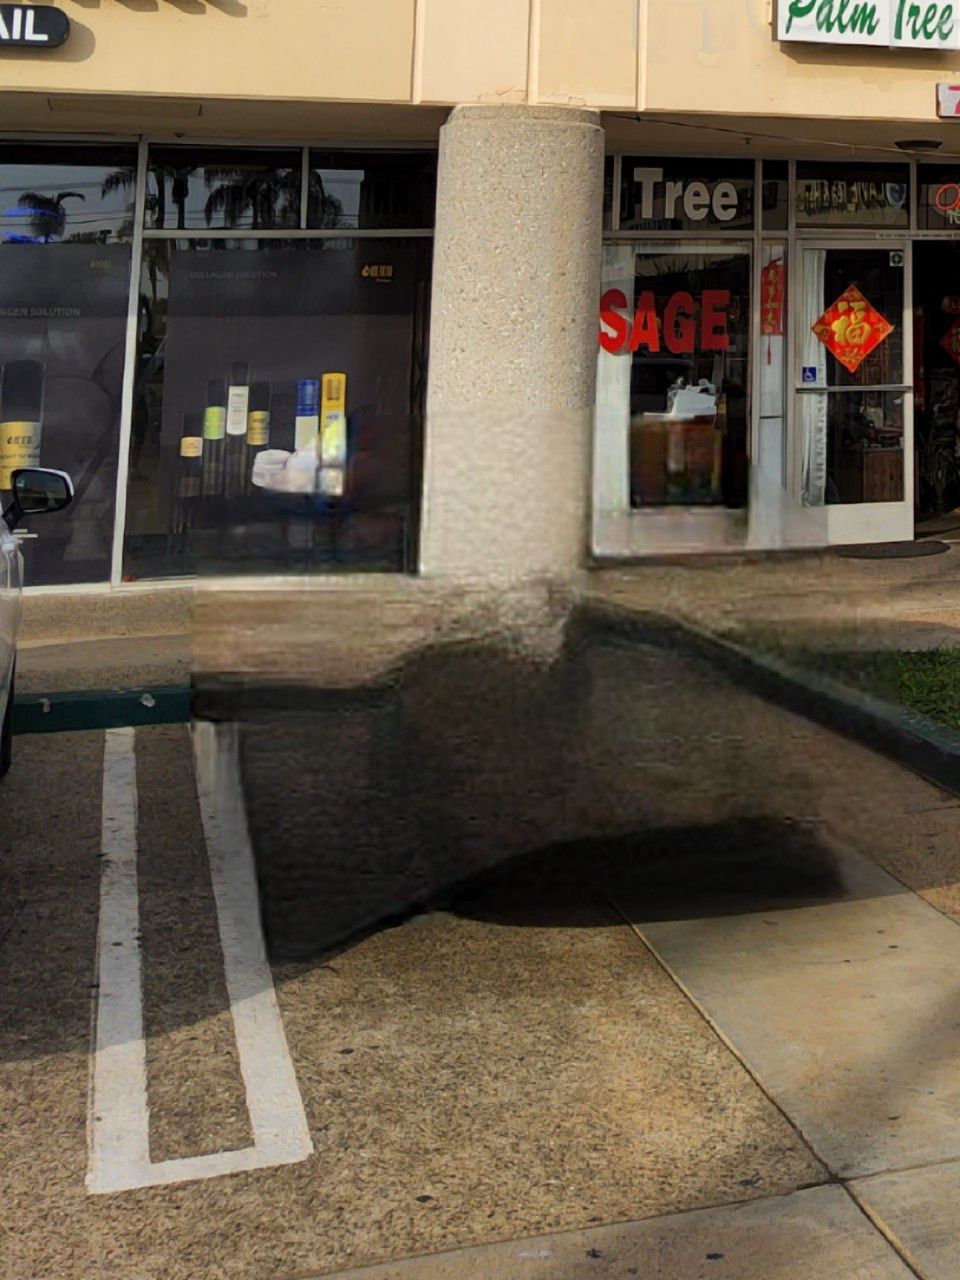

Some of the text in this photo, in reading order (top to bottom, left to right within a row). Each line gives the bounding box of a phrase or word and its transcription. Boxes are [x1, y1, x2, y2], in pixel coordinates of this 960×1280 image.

[634, 167, 739, 221] Tree
[597, 288, 732, 355] SAGE
[830, 301, 871, 346] 福
